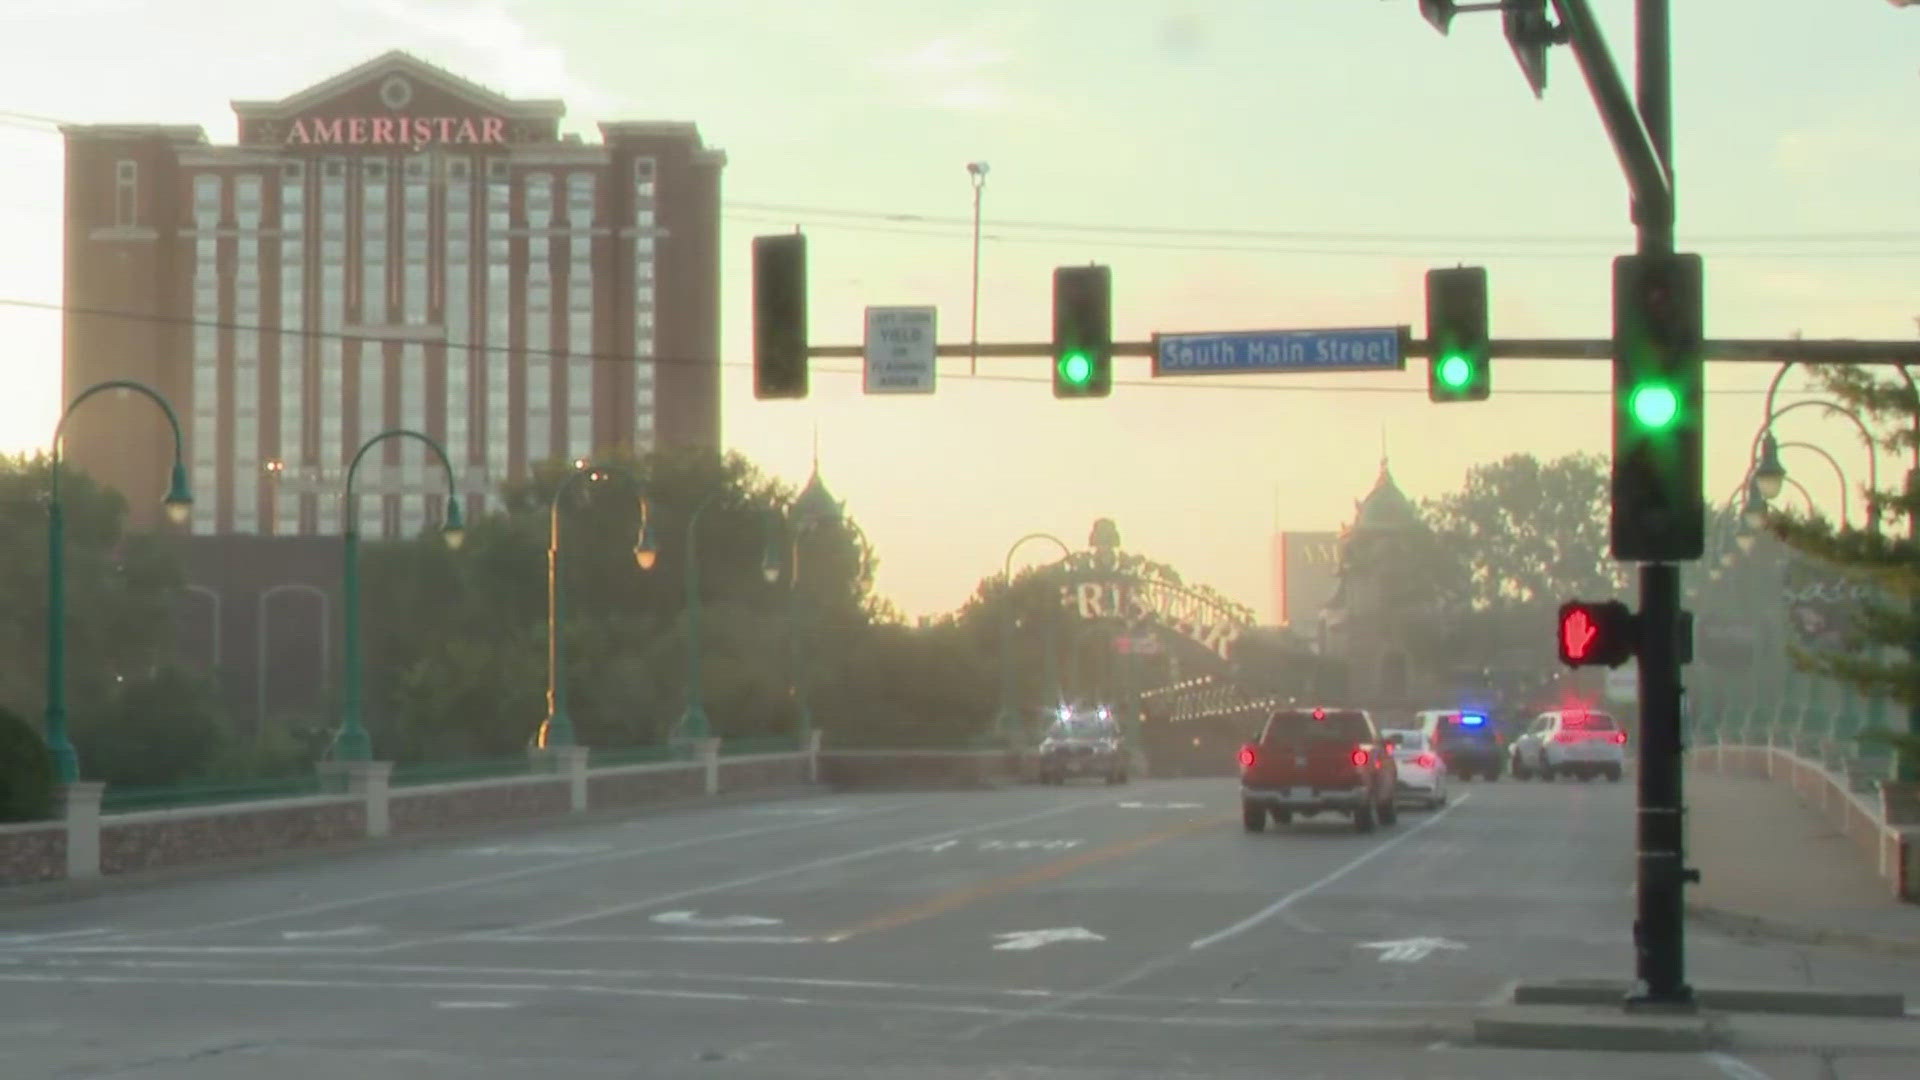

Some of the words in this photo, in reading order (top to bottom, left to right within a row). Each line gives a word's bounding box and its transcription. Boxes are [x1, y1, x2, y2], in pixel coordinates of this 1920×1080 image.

[286, 117, 505, 146] AMERISTAR
[880, 327, 922, 342] YIELD
[1164, 340, 1235, 366] South
[1249, 336, 1305, 363] Main
[1317, 332, 1392, 361] Street
